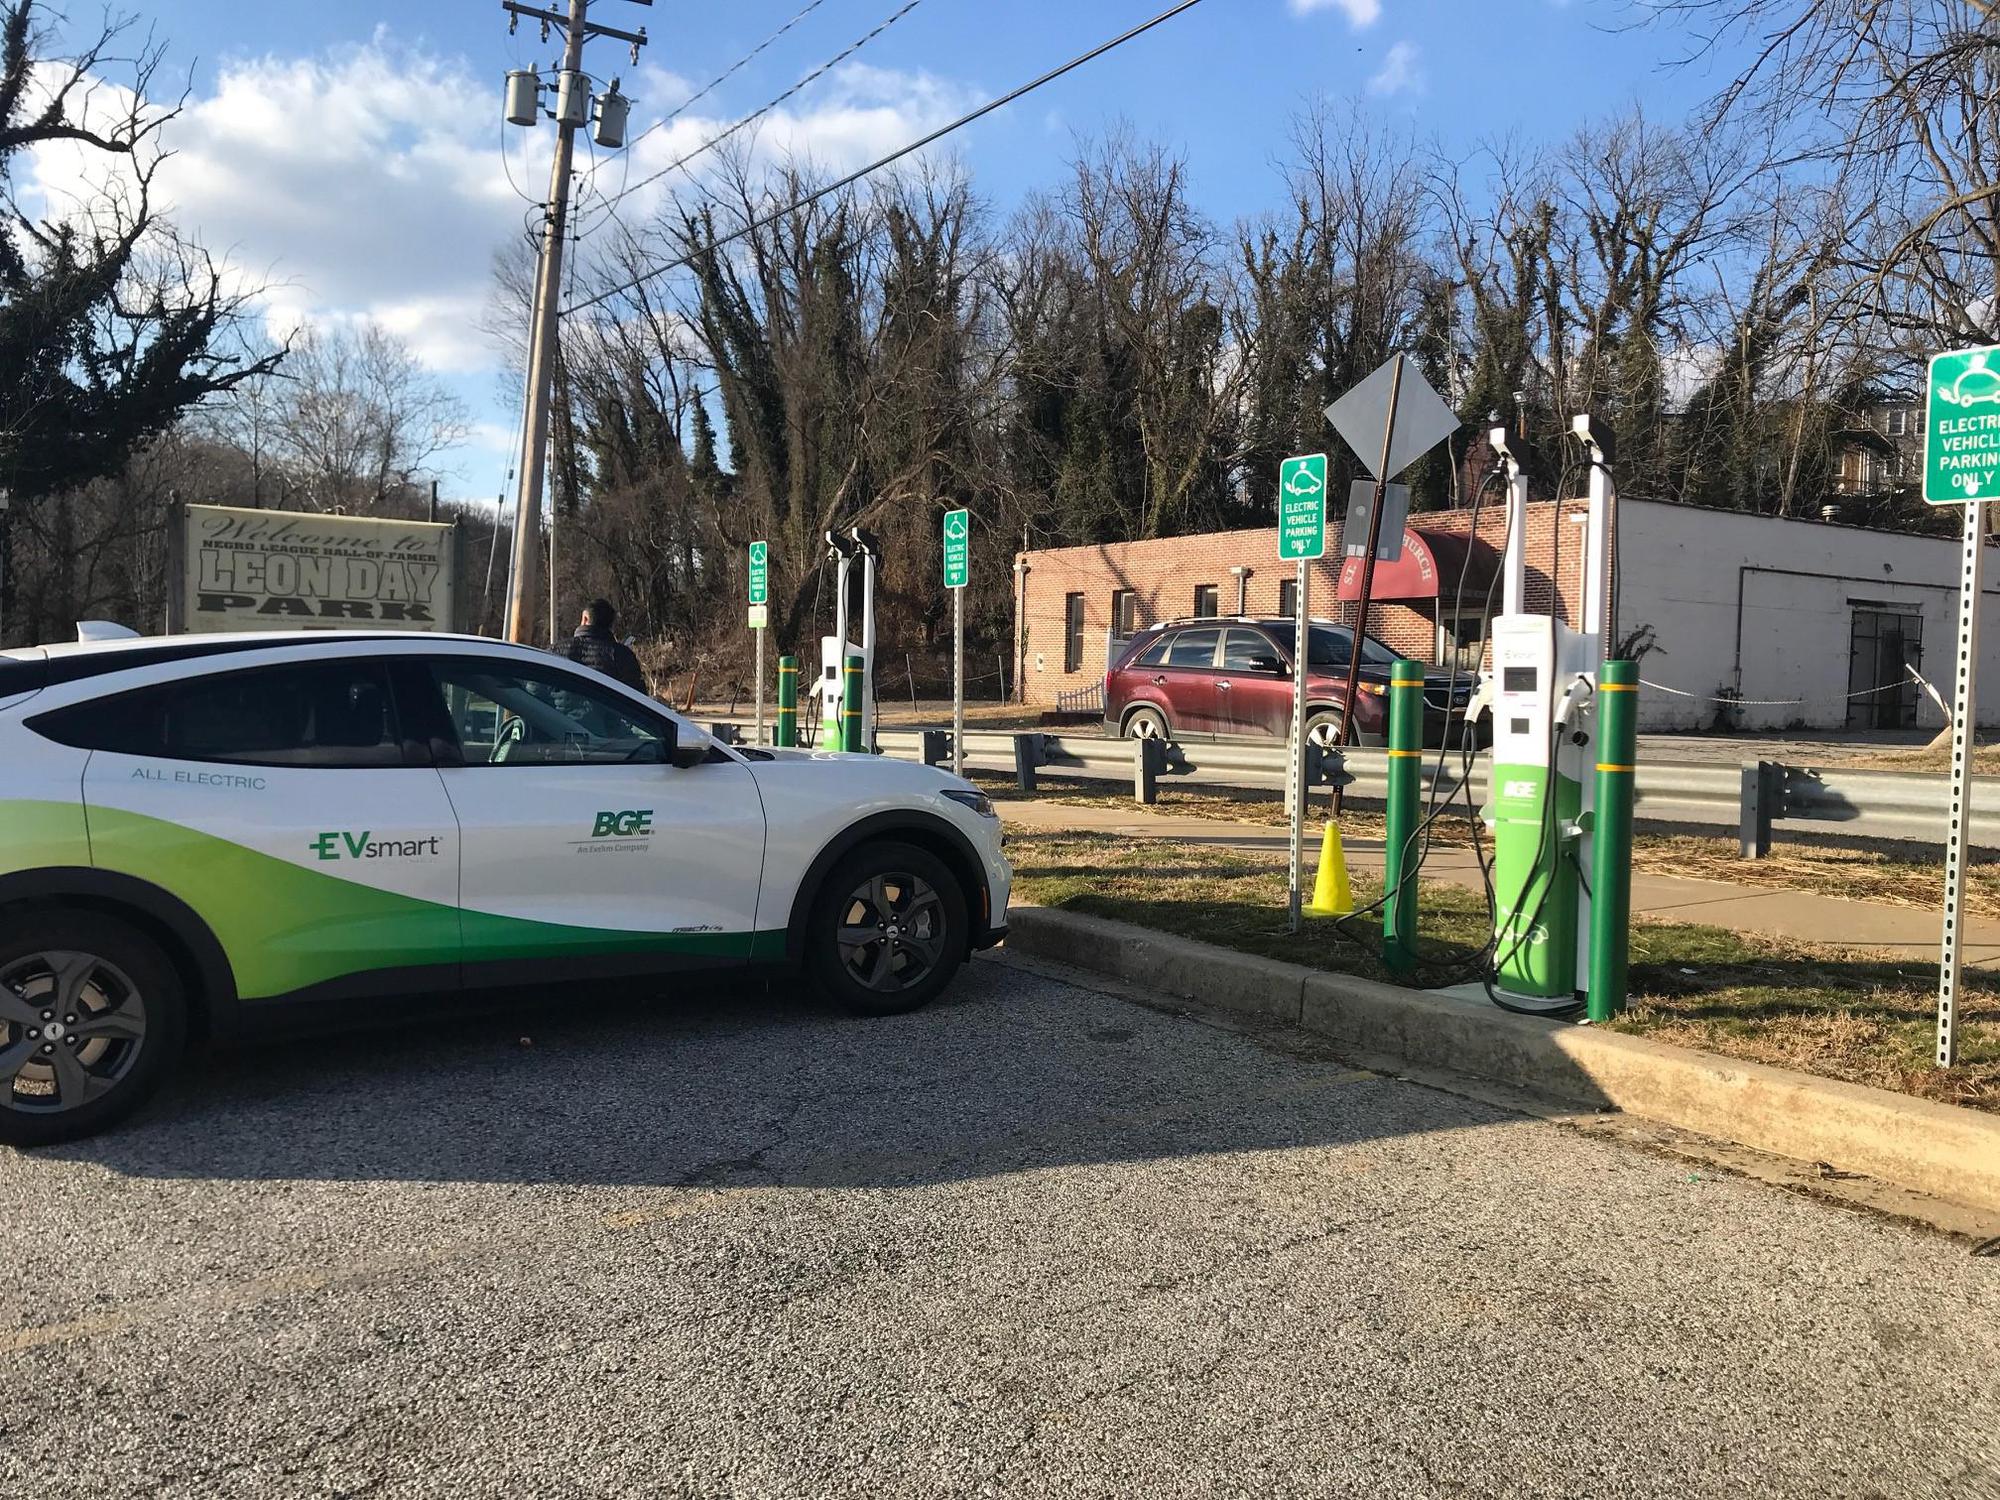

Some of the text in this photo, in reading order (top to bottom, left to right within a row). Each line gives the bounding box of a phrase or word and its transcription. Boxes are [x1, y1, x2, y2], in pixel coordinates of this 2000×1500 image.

[1939, 415, 2000, 435] ELECTRI
[1942, 433, 2000, 452] VEHICL
[1940, 452, 2000, 471] PARKIN
[1951, 470, 1995, 488] ONLY
[1285, 501, 1319, 513] ELECTRIC
[1286, 513, 1317, 526] VEHICLE
[202, 516, 437, 551] Welcome to
[1285, 525, 1317, 538] PARKING
[203, 540, 437, 563] NEGRO LEAGUE HALL-OF-FAMER
[1291, 538, 1312, 550] ONLY
[1402, 533, 1432, 581] HURCH
[199, 548, 439, 603] LEON DAY
[196, 593, 436, 622] PARK
[131, 767, 266, 791] ALL ELECTRIC
[591, 809, 653, 837] BGE
[309, 831, 440, 860] EVsmart
